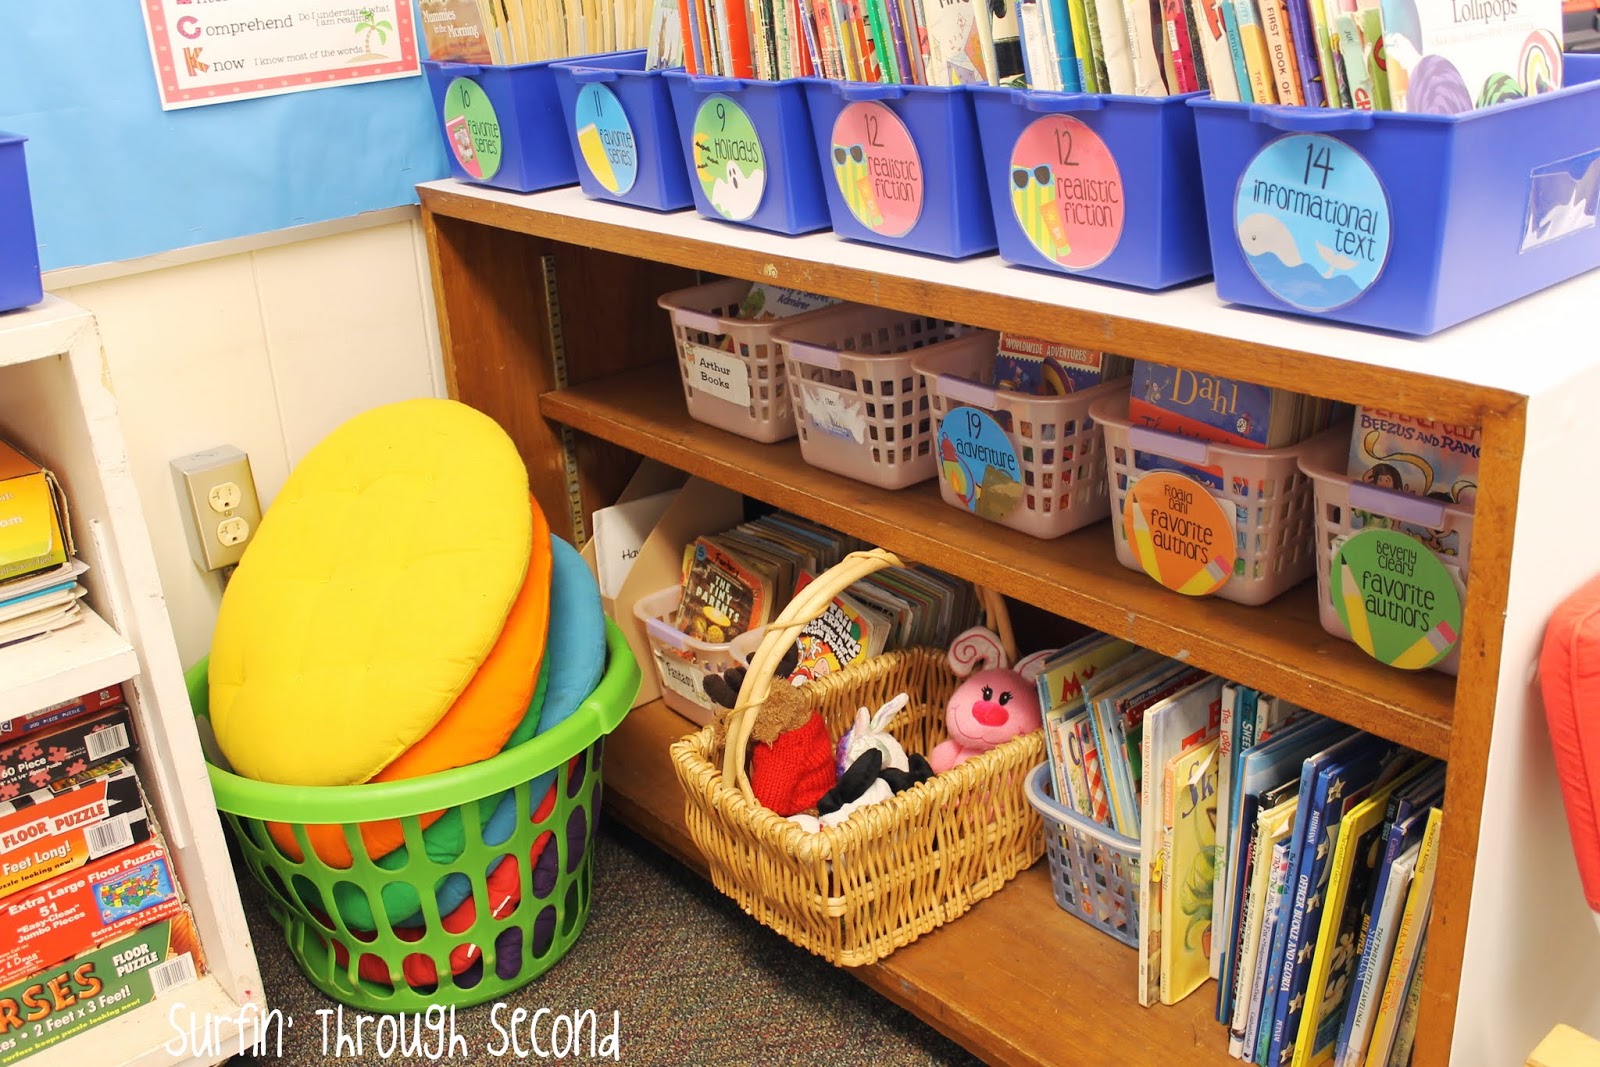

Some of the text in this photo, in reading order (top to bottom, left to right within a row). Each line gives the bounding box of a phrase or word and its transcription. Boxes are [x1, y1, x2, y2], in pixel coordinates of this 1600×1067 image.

[177, 15, 293, 39] Comprehend
[315, 7, 367, 19] understand
[368, 4, 390, 14] what
[422, 8, 456, 23] Mummies
[433, 23, 480, 38] in the Morning
[182, 47, 335, 76] Know know most of the
[1266, 7, 1291, 96] FIRST BOOK OF
[1253, 71, 1262, 87] THE
[467, 119, 499, 138] favorite
[716, 103, 726, 132] 9
[863, 113, 884, 148] 12
[474, 136, 498, 155] series
[600, 128, 633, 148] favorite
[1053, 126, 1079, 166] 12
[608, 147, 632, 167] series
[867, 155, 918, 181] realistic
[1303, 142, 1335, 191] 14
[875, 178, 915, 203] fiction
[1056, 174, 1118, 204] realistic
[1064, 201, 1113, 228] fiction
[1253, 178, 1379, 237] informational
[1335, 227, 1376, 263] text
[777, 294, 810, 310] Admirer
[1005, 338, 1043, 355] WORLDWIDE
[1046, 345, 1087, 362] ADVENTURES
[700, 358, 731, 376] Arthur
[701, 371, 730, 390] Books
[1169, 367, 1238, 415] Dahl
[966, 409, 982, 440] 19
[1360, 413, 1416, 440] BEEZUS
[1415, 431, 1441, 447] AND
[956, 438, 1016, 471] adventure
[1150, 508, 1213, 546] favorite
[1152, 530, 1208, 565] authors
[1376, 540, 1417, 565] Beverly
[1377, 555, 1415, 578] Cleary
[709, 583, 733, 606] TINY
[715, 575, 731, 593] THE
[1362, 570, 1435, 611] favorite
[695, 586, 741, 624] PARENTS
[1365, 594, 1430, 632] authors
[43, 714, 59, 724] PIECE
[62, 708, 81, 718] PUZZLE
[1219, 708, 1231, 758] The LORAX
[1, 757, 47, 779] 60 Piece
[46, 760, 63, 770] Puzzle
[2, 802, 106, 849] FLOOR PUZZLE
[1307, 810, 1321, 845] RATHMANN
[2, 840, 72, 877] Feet Long!
[1387, 837, 1399, 864] Cannon
[8, 896, 46, 917] Extra
[49, 879, 86, 900] Large
[87, 865, 120, 884] Floor
[123, 849, 164, 870] Puzzle
[21, 857, 75, 883] looking new!
[1286, 862, 1296, 885] Rainbow
[1283, 884, 1291, 896] Fish
[39, 902, 58, 918] 51
[91, 926, 113, 939] Extra
[113, 915, 139, 932] Large,
[152, 906, 158, 914] 3
[158, 899, 179, 911] Feet!
[1361, 912, 1371, 932] MATH
[17, 911, 86, 944] Jumbo Pieces
[1244, 920, 1253, 954] ORCHESTRA
[1280, 874, 1309, 991] OFFICER BUCKLE AND GLORIA
[112, 943, 150, 967] FLOOR
[116, 951, 159, 979] PUZZLE
[1357, 928, 1376, 981] STELLALUNA
[1355, 927, 1384, 1028] THE THREE LITTLE JAVELINAS
[34, 985, 132, 1038] 2 Feet x 3 Feet!
[2, 998, 141, 1064] surface keeps puzzle looking new!
